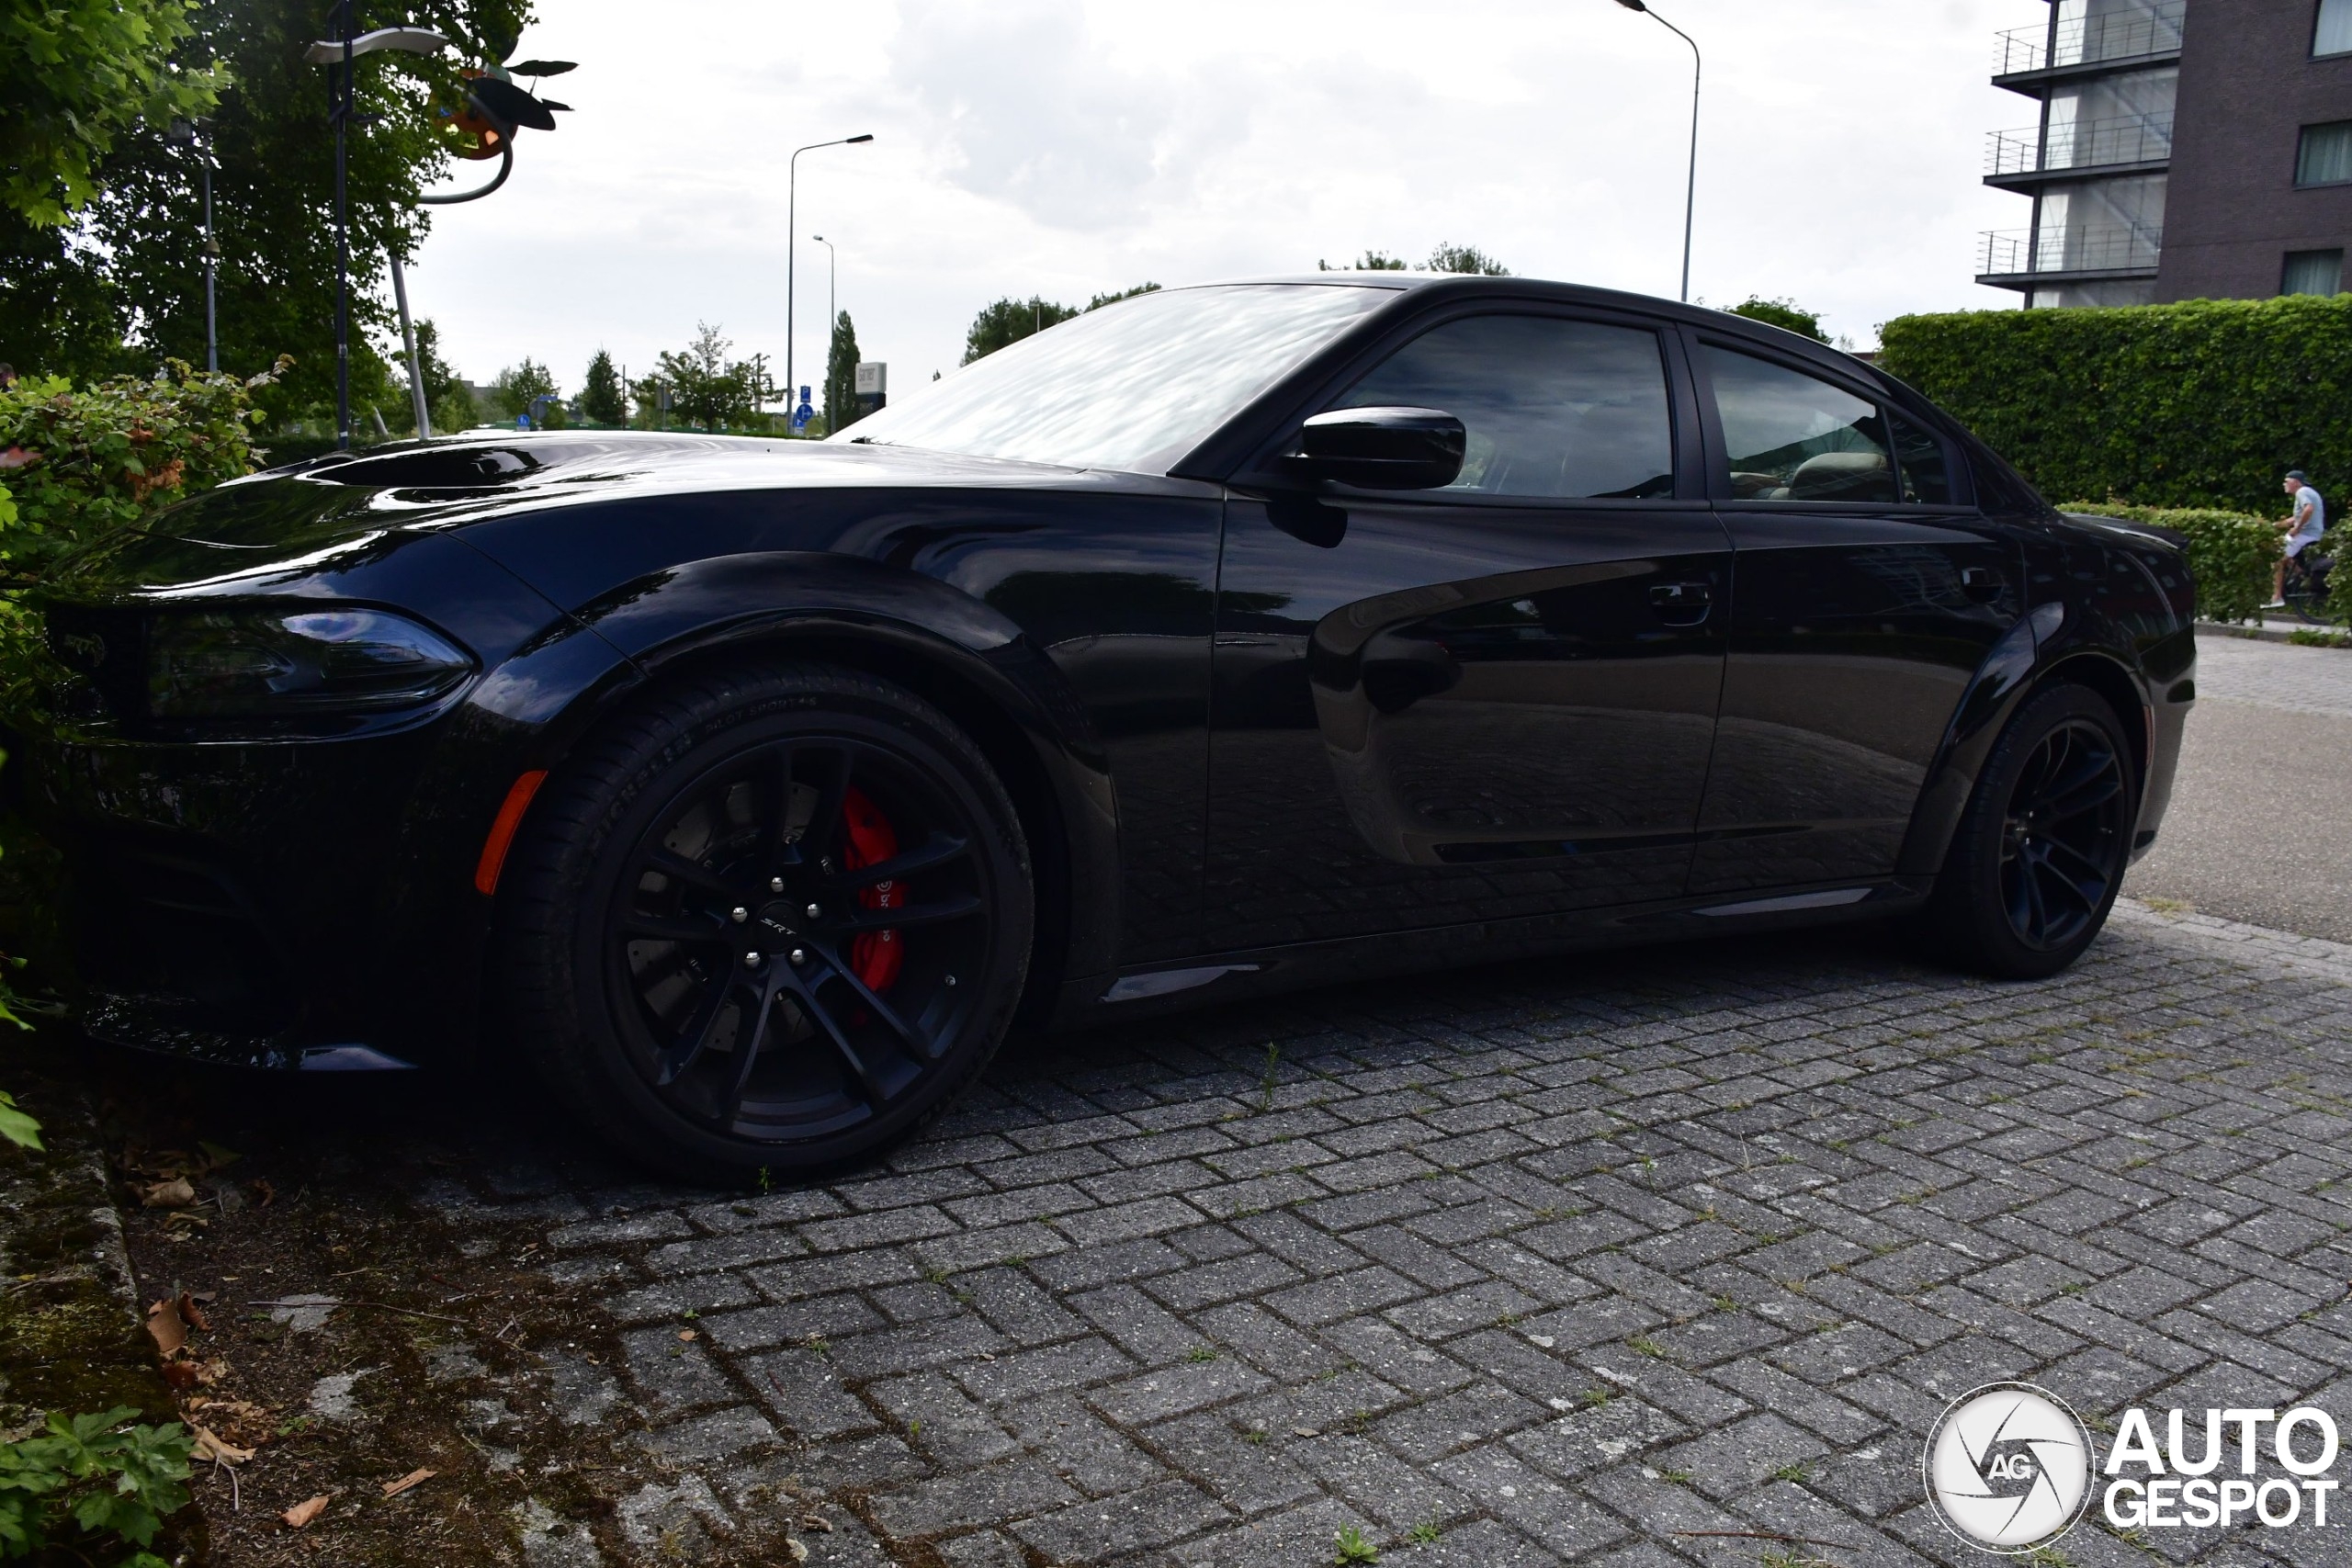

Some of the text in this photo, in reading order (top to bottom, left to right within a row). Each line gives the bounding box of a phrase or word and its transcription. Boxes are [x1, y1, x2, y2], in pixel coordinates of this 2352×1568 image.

[802, 388, 809, 397] P
[705, 711, 745, 736] PILOT
[749, 698, 795, 717] SPORT
[760, 918, 797, 935] SRT
